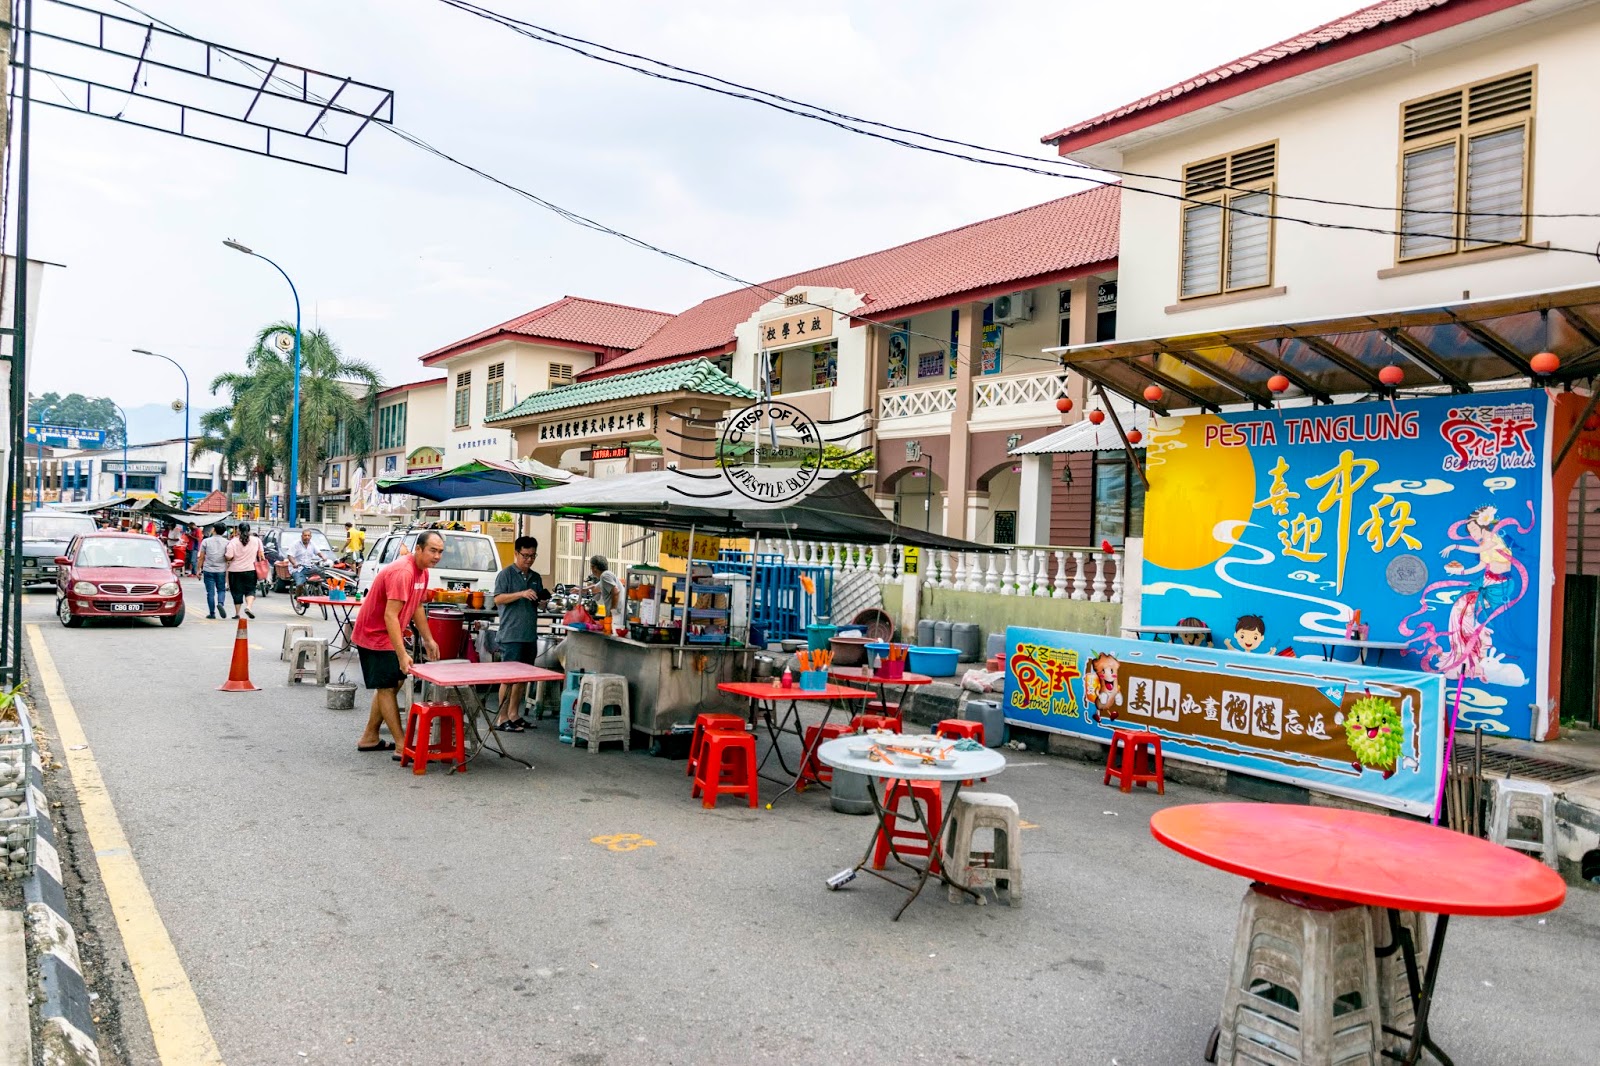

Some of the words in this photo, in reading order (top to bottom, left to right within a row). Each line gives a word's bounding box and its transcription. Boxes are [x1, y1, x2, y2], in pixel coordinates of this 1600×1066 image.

[1205, 420, 1276, 448] PESTA
[1287, 411, 1420, 445] TANGLUNG
[1502, 452, 1536, 468] Walk
[1053, 699, 1079, 717] Walk
